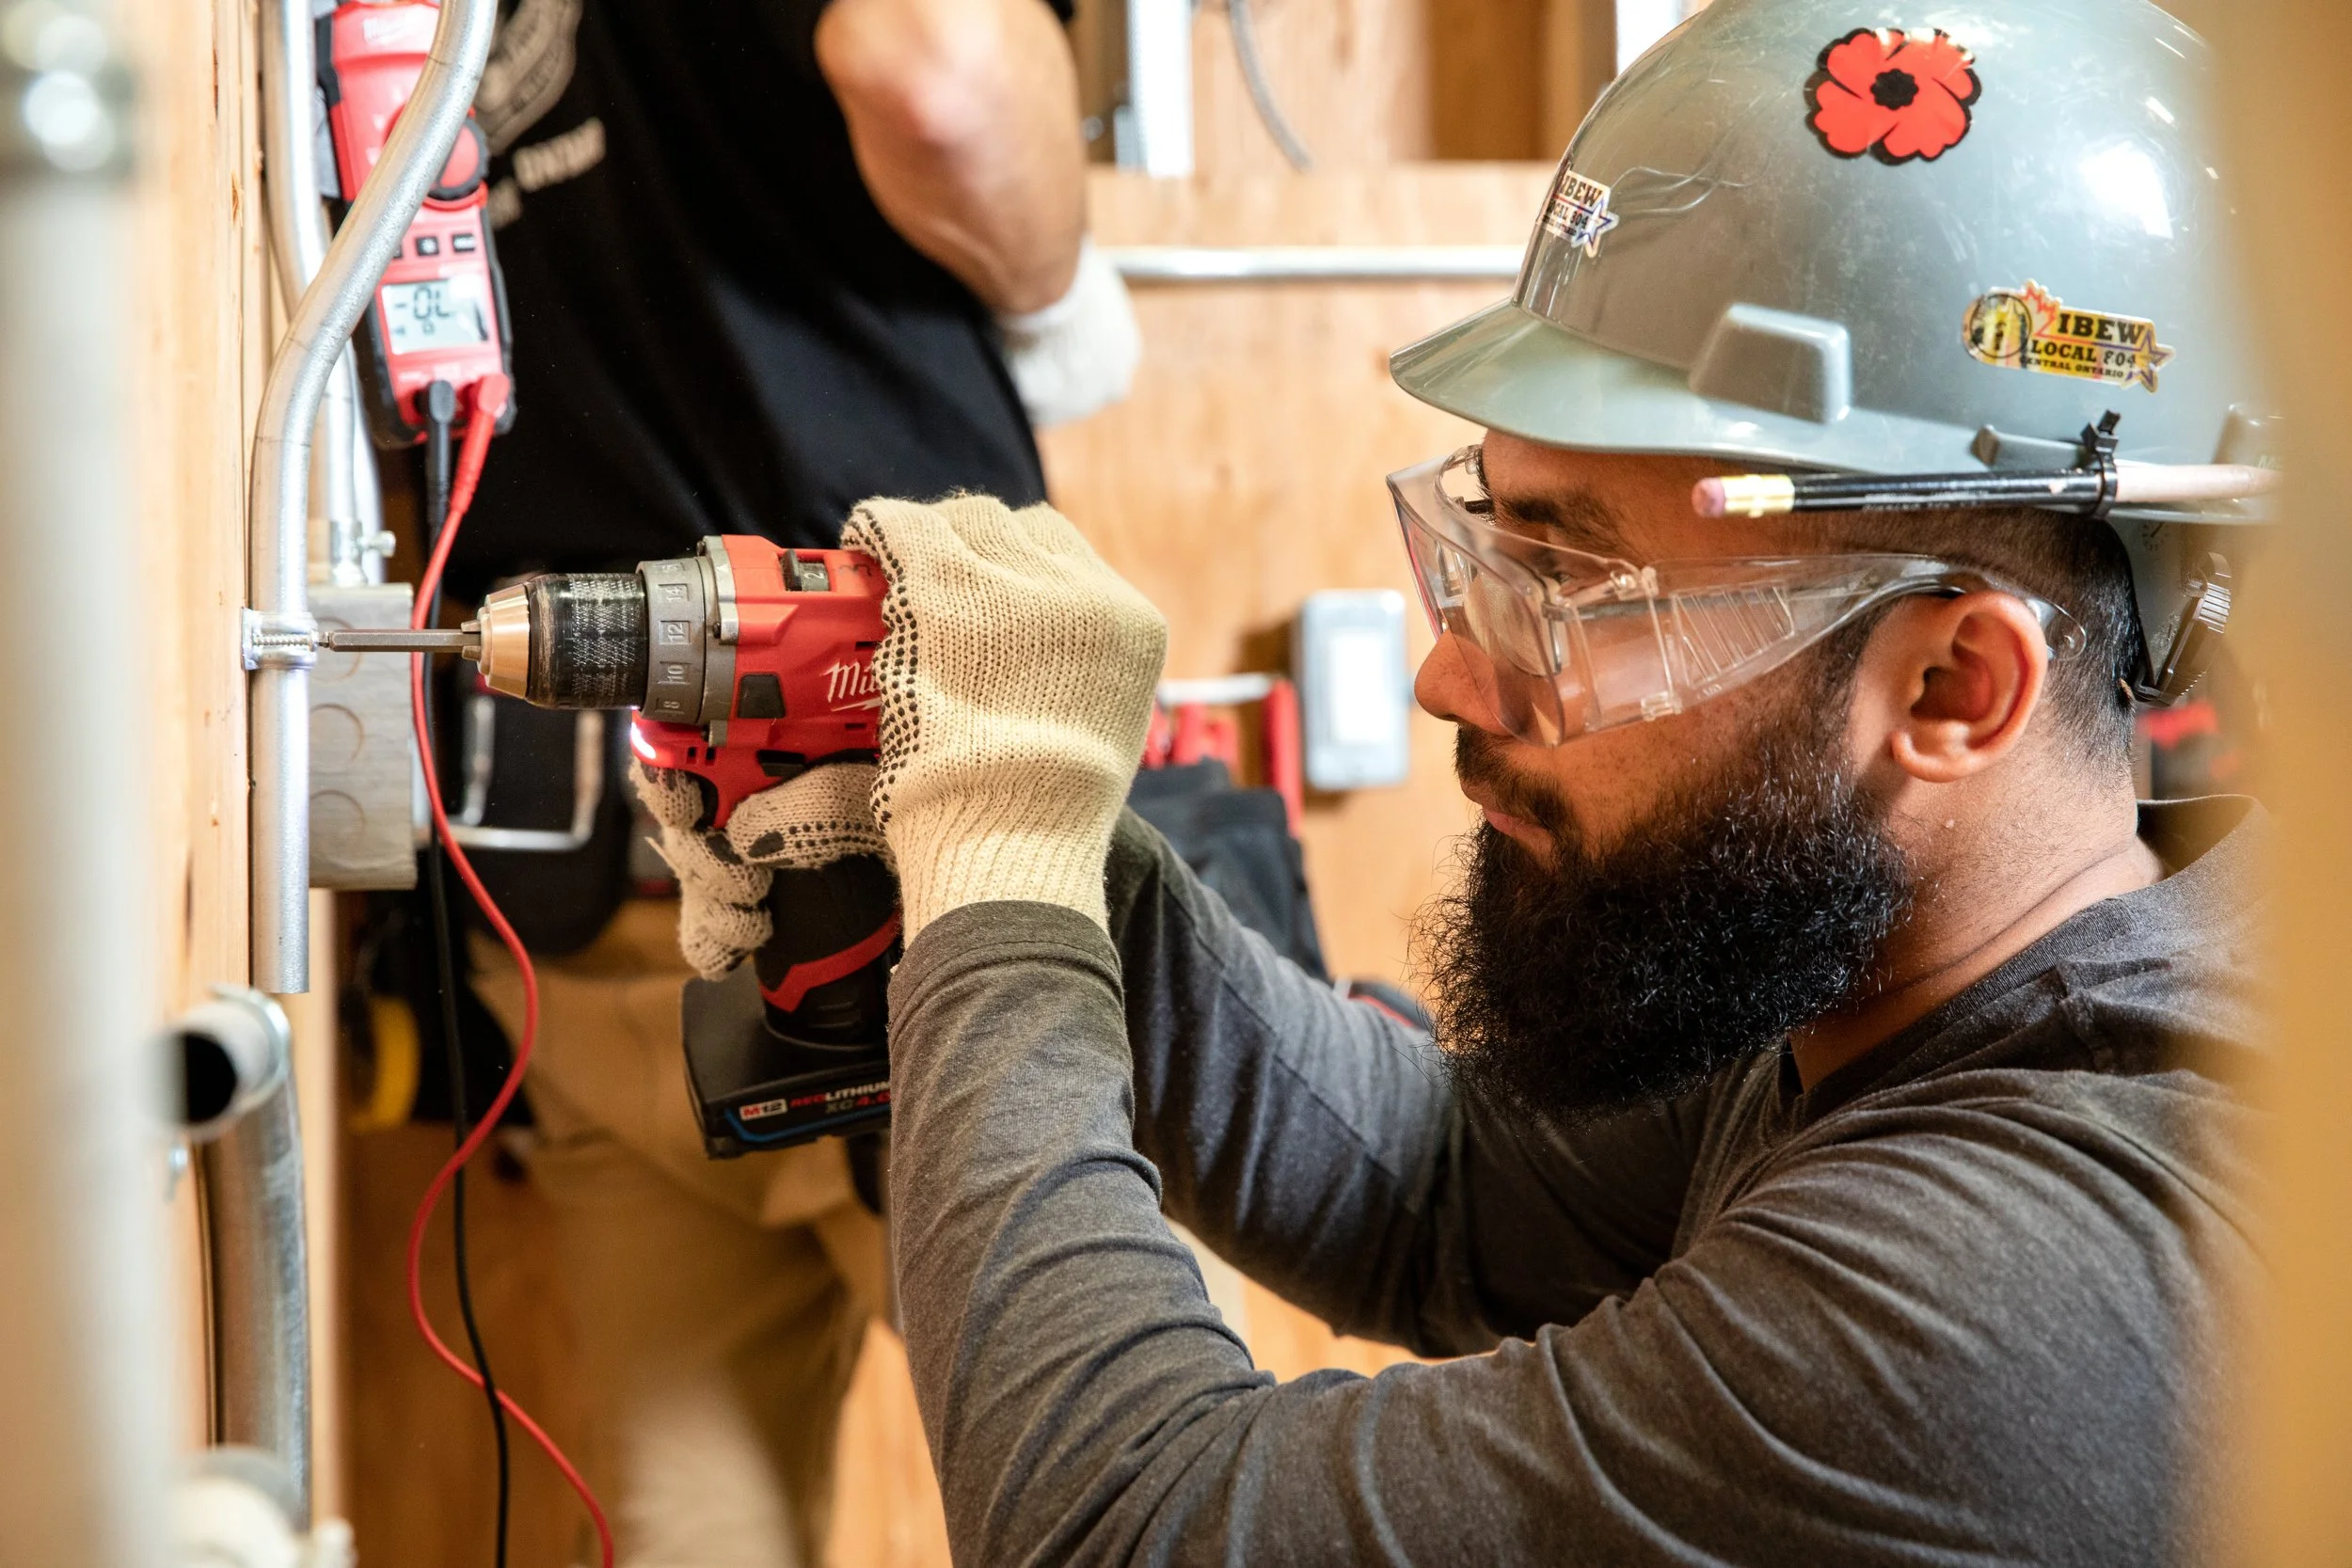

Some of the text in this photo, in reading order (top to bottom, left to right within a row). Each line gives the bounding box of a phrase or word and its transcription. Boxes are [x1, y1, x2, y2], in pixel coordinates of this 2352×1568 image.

[2058, 313, 2145, 345] IBEW
[2032, 340, 2097, 364] LOCAL
[2074, 362, 2124, 377] ONTARIO
[665, 585, 683, 603] 14
[667, 622, 686, 641] 12
[667, 664, 685, 682] 10
[663, 700, 680, 709] 8
[742, 1101, 783, 1117] M12
